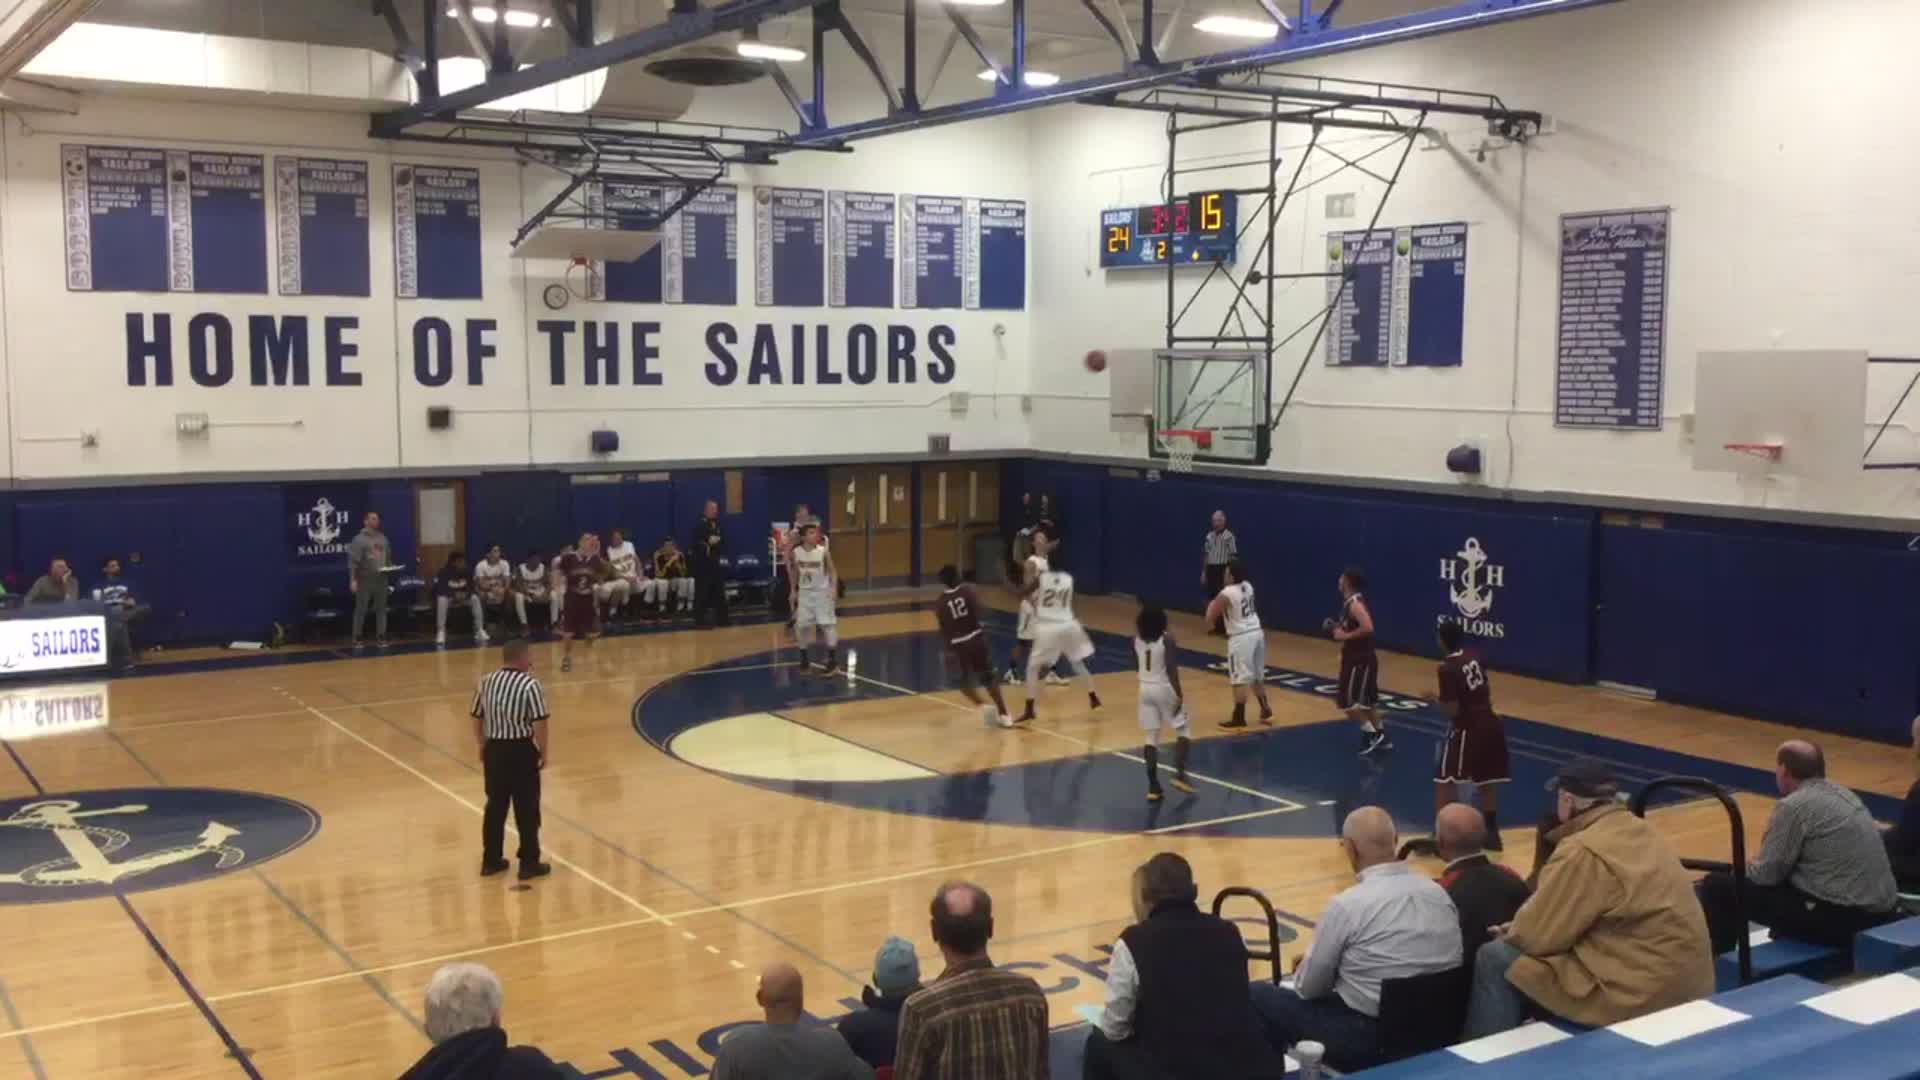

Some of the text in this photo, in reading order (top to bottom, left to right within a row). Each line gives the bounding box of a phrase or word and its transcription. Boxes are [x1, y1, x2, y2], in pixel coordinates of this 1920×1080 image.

[1201, 194, 1220, 230] 15
[1108, 227, 1129, 252] 24
[1157, 241, 1166, 260] 2
[126, 312, 956, 388] HOME OF THE SAILORS
[298, 510, 349, 526] H H
[1440, 558, 1504, 587] H H
[947, 597, 969, 619] 12
[1437, 614, 1504, 638] SLORS
[32, 627, 100, 657] SAILORS
[1145, 649, 1151, 672] 1
[1463, 660, 1484, 691] 23
